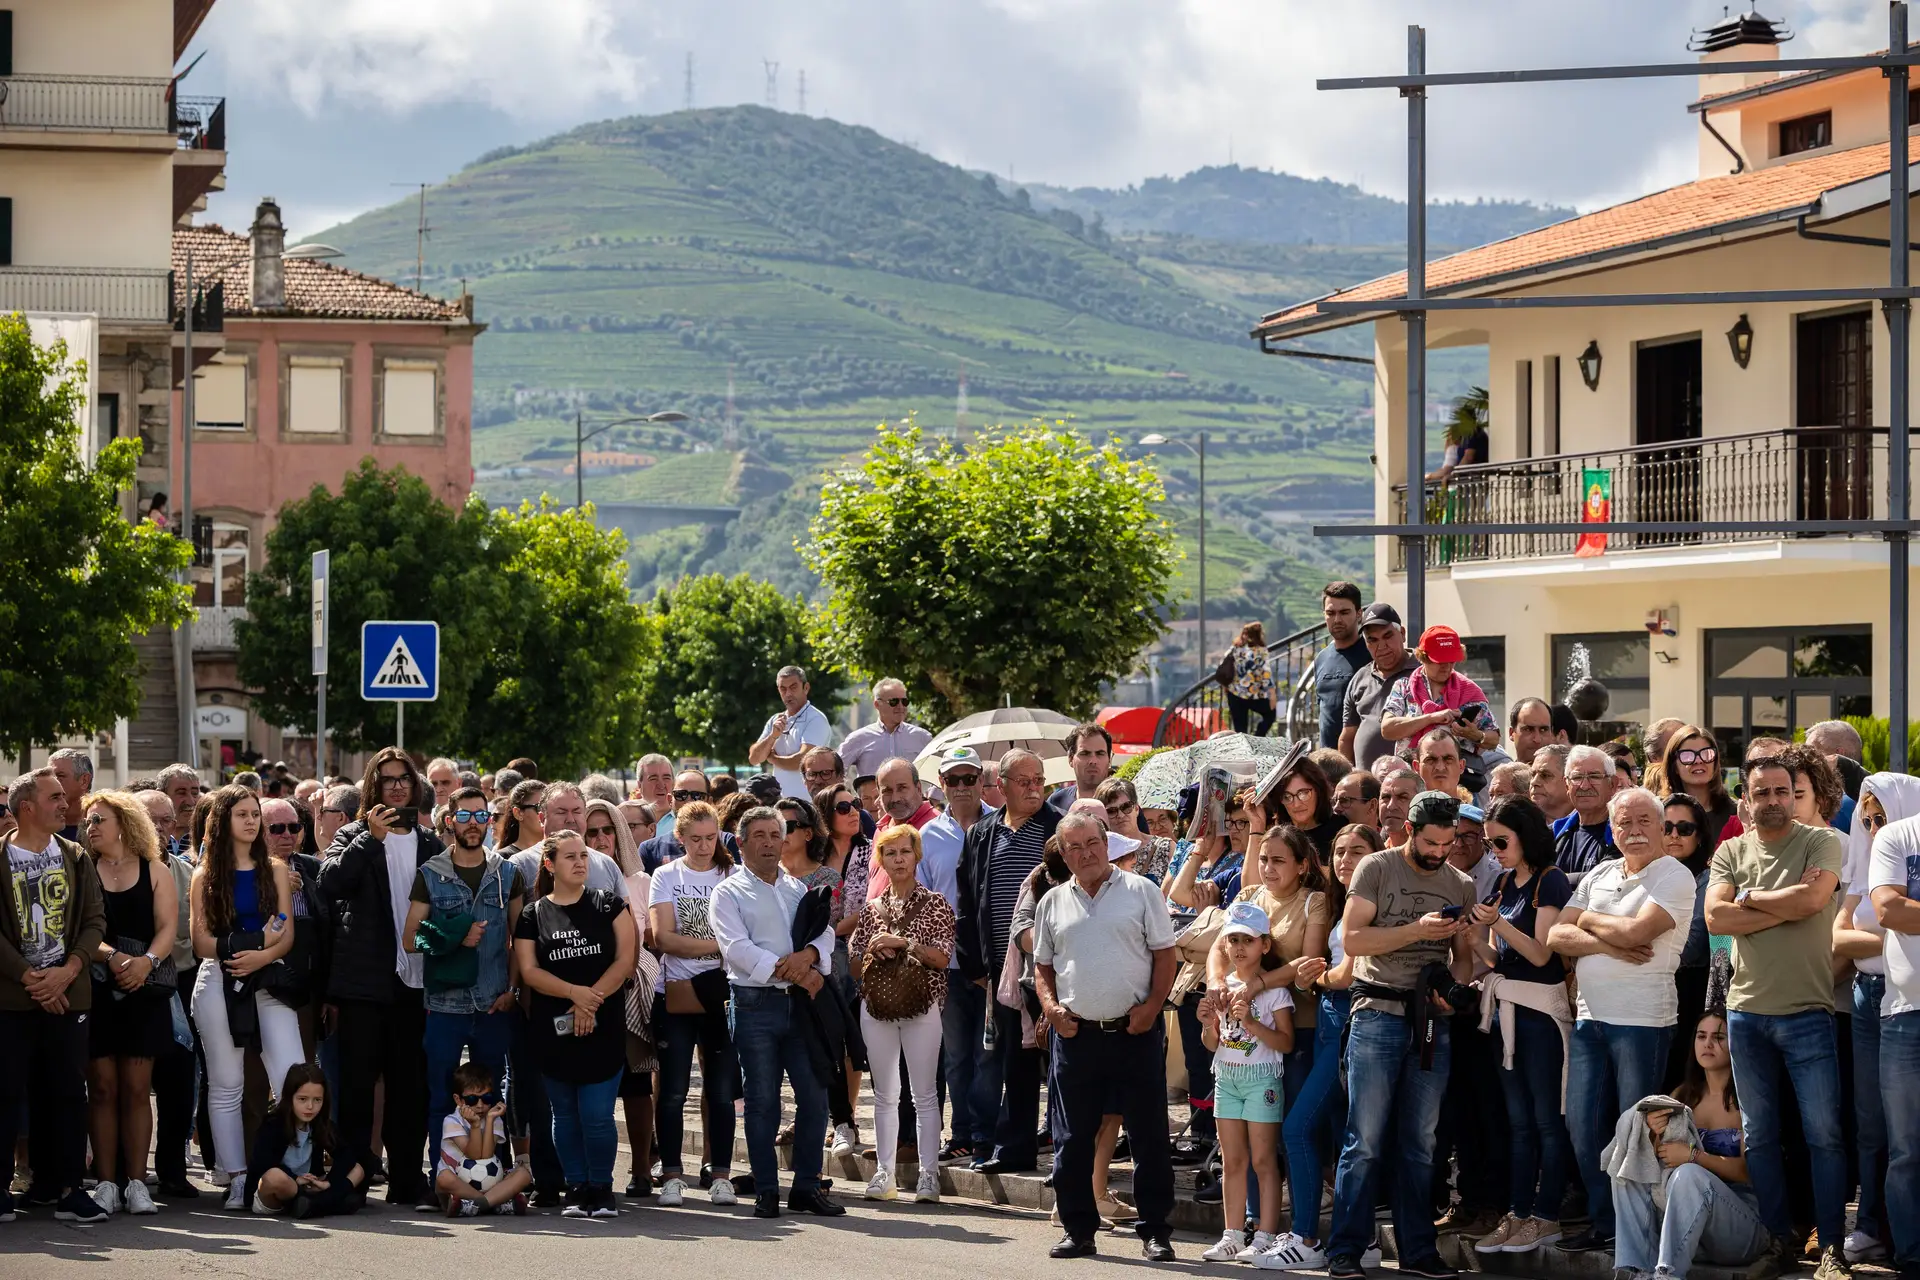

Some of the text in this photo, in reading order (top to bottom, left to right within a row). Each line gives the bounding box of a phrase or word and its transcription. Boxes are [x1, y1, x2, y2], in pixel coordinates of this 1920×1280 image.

[202, 712, 230, 726] NOS
[552, 929, 580, 939] dare
[573, 937, 587, 947] be
[549, 943, 602, 961] different
[1425, 1019, 1434, 1043] Canon
